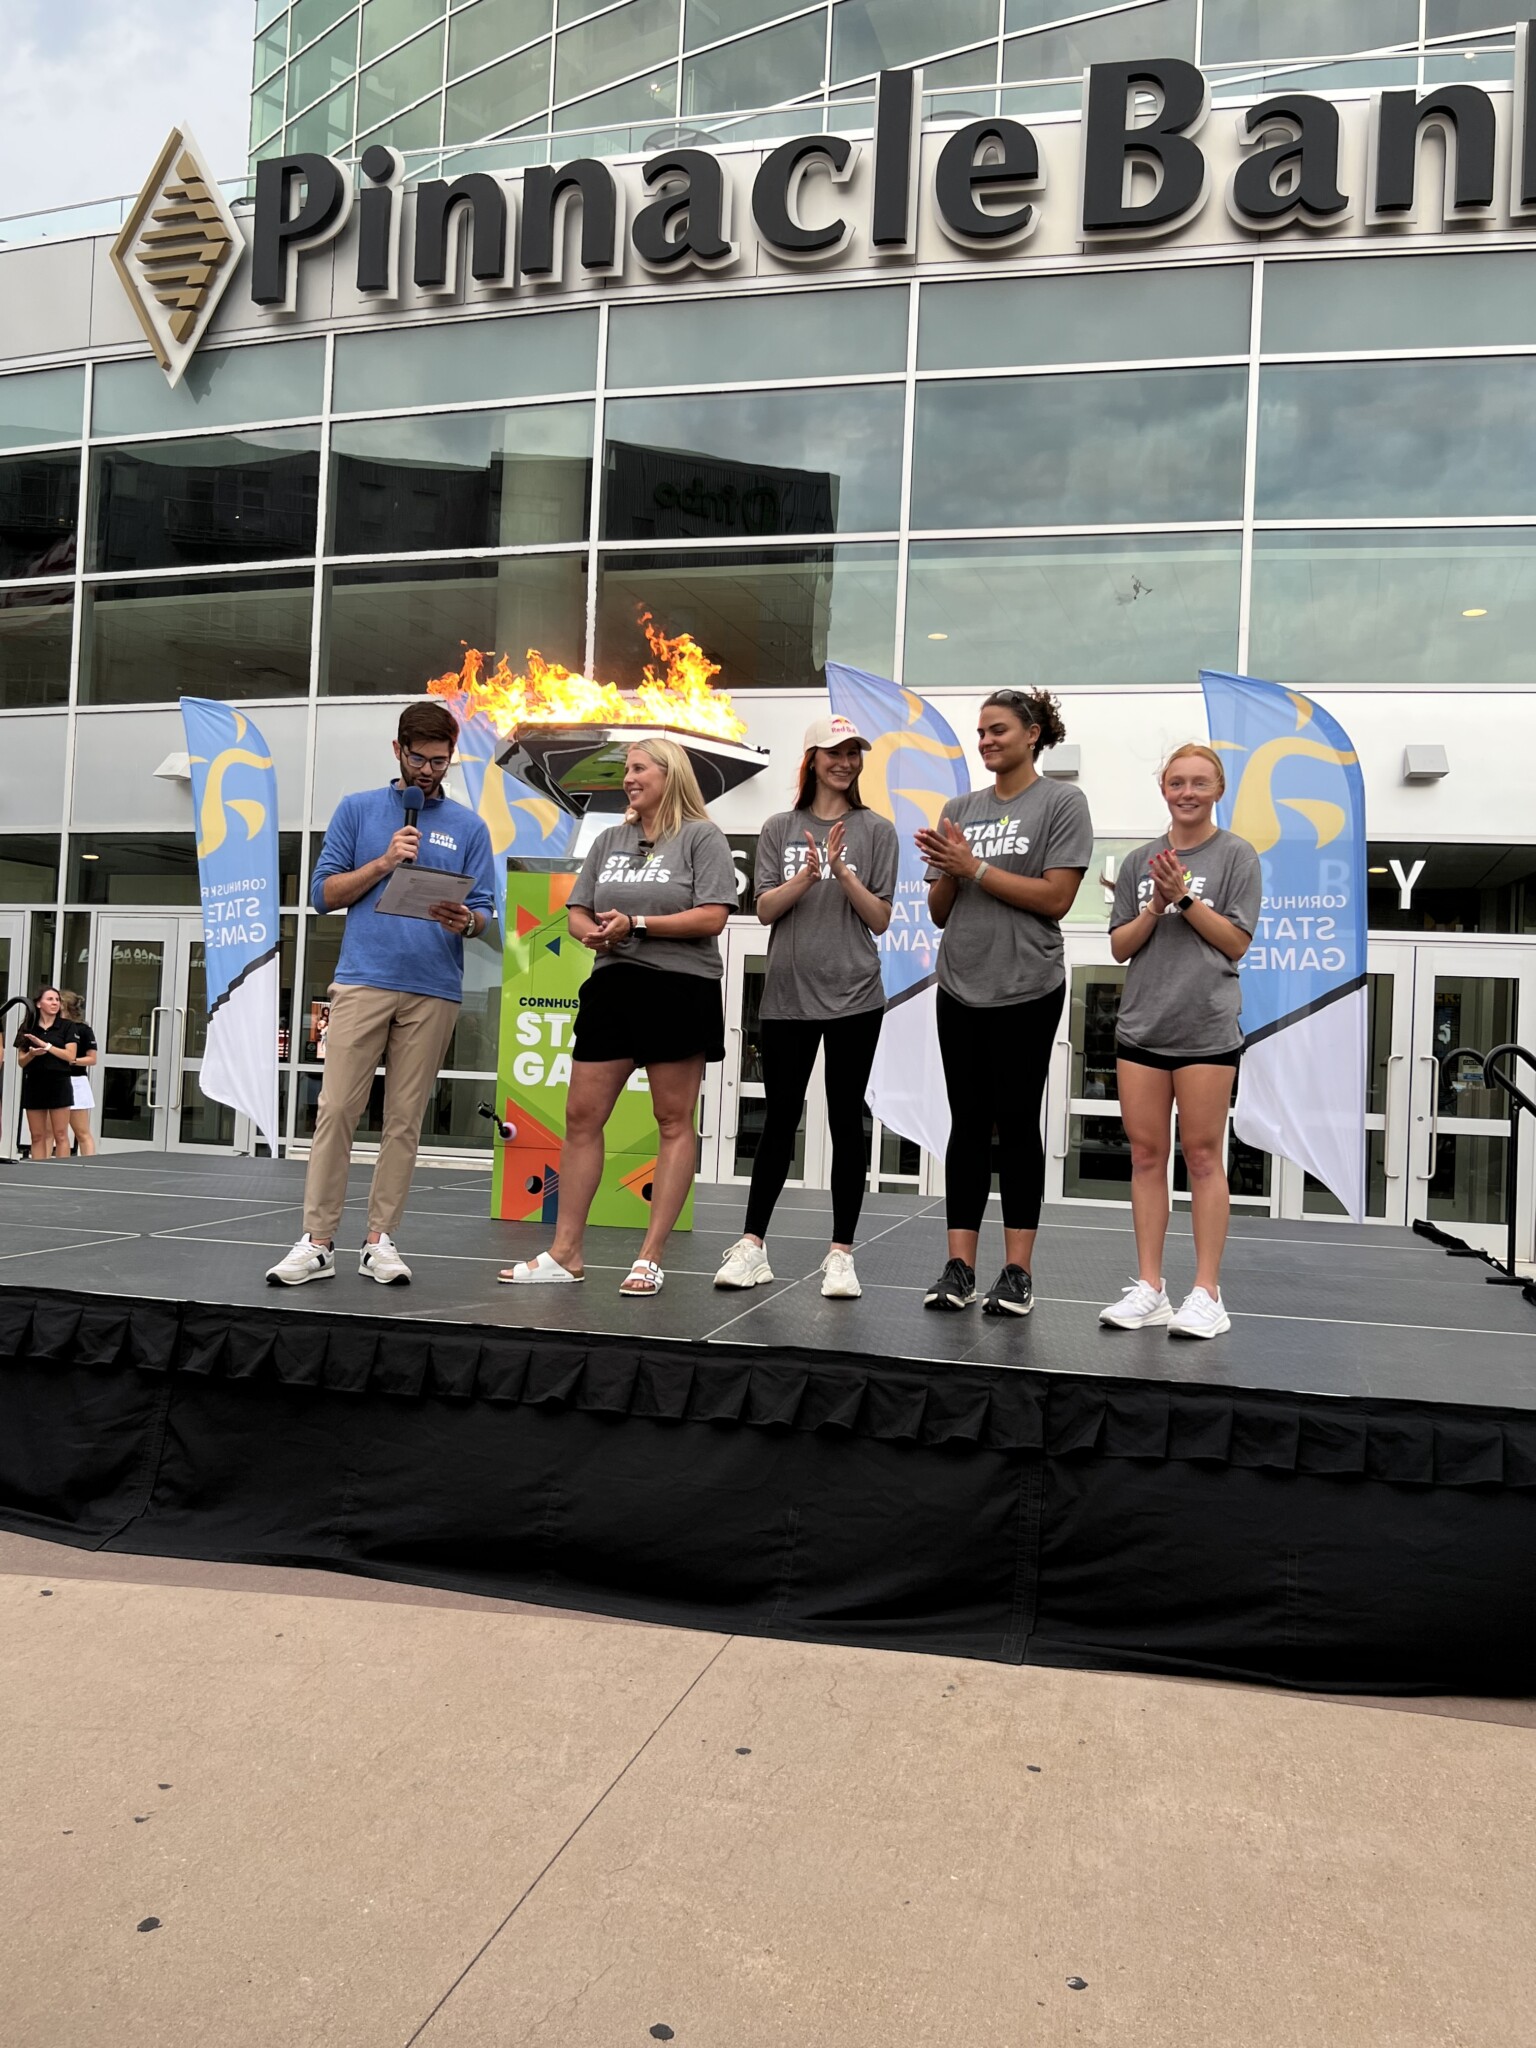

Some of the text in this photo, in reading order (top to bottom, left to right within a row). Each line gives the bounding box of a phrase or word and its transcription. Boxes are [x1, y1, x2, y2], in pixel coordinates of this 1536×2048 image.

[251, 19, 1536, 313] Pinnacle Ban
[430, 832, 454, 843] STATE
[962, 819, 1021, 842] STATE
[429, 838, 457, 851] GAMES
[971, 836, 1030, 859] AMES
[605, 854, 664, 869] STE
[598, 868, 671, 884] GAMES
[1137, 876, 1207, 899] STE
[519, 997, 579, 1009] CORNHUS
